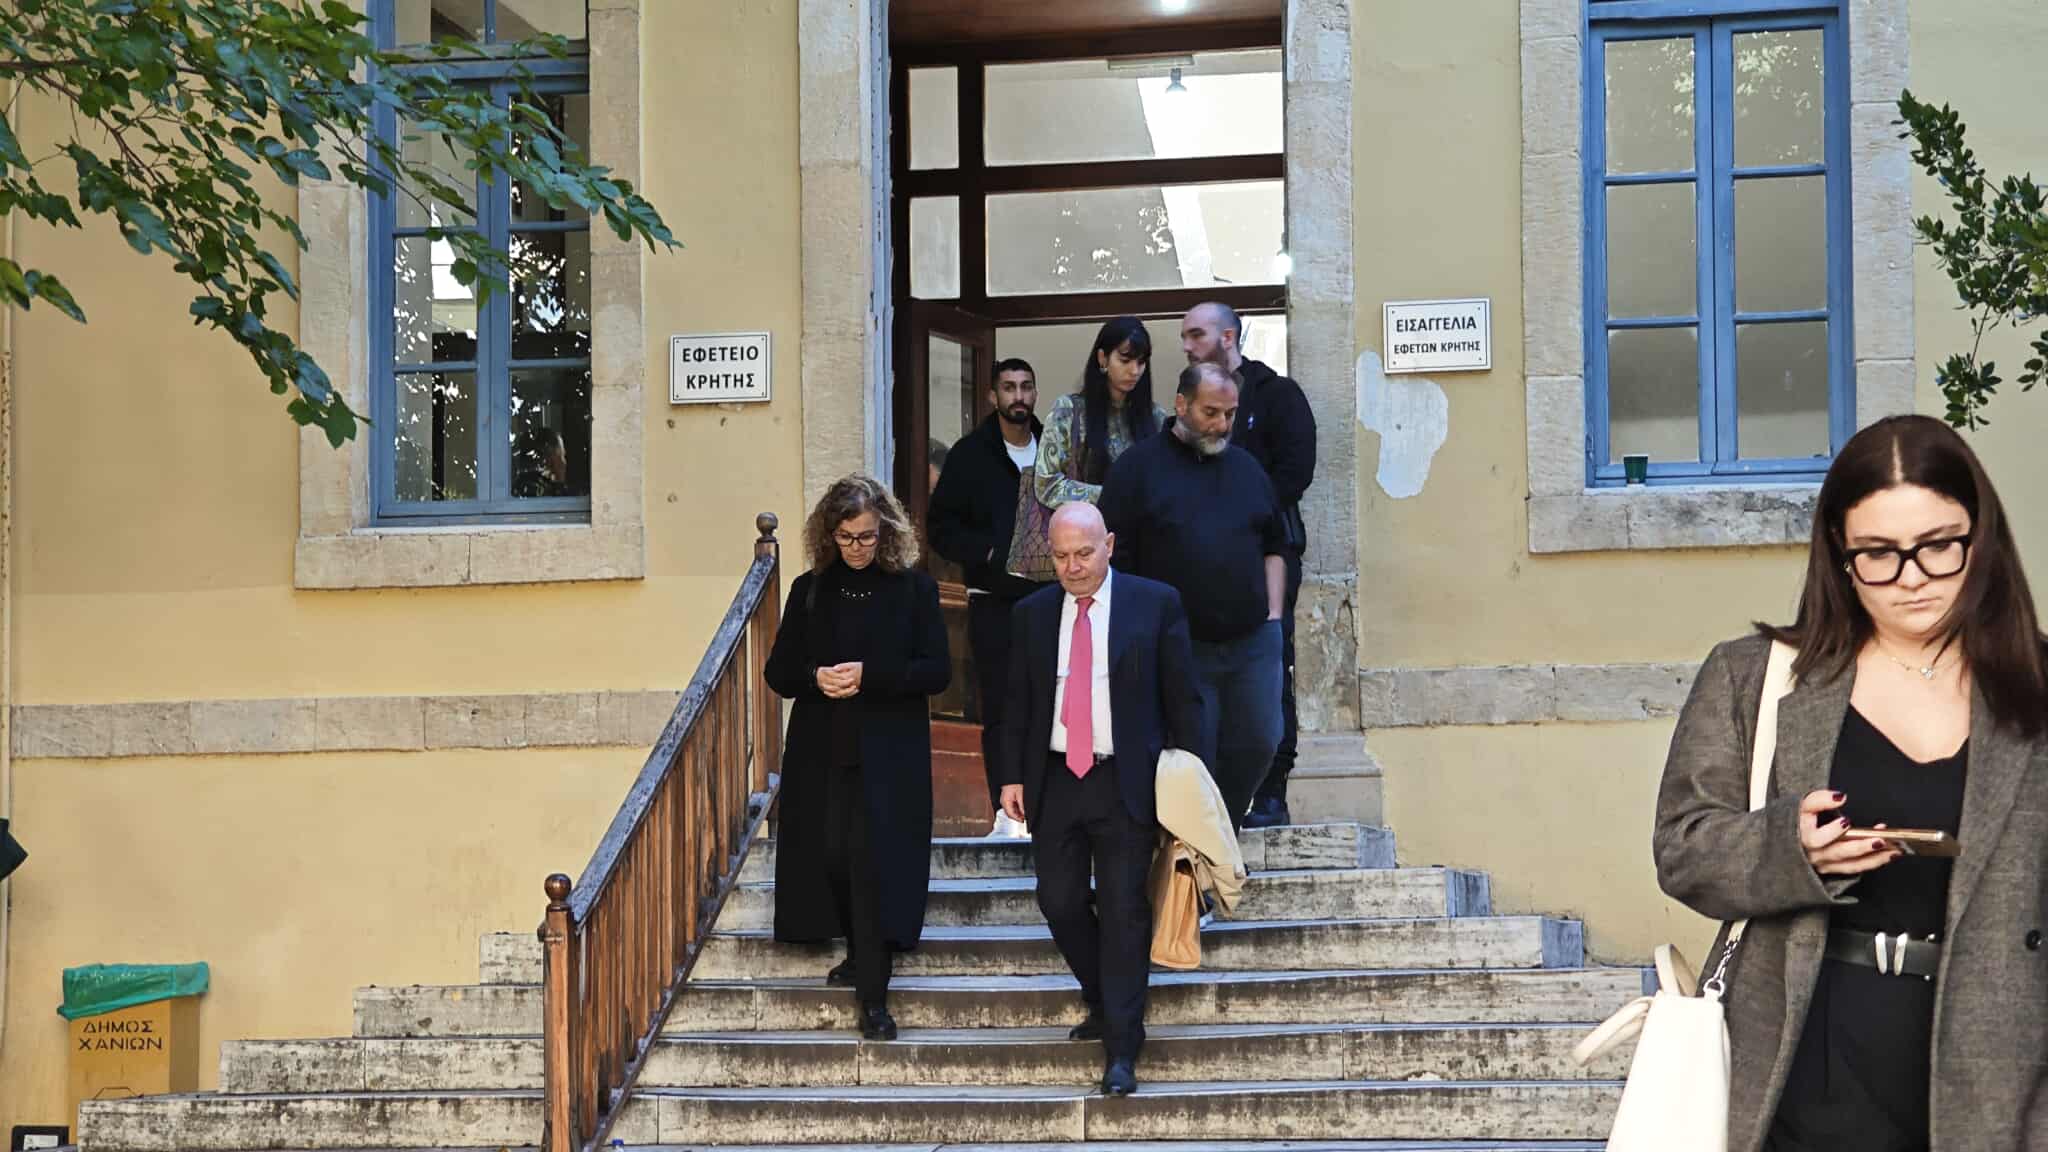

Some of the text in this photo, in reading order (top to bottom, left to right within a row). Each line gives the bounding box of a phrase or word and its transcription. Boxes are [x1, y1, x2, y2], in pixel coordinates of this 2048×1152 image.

[1396, 316, 1477, 333] ΕΙΣΑΓΓΕΛΙΑ
[682, 345, 759, 363] ΕΦΕΤΕΙΟ
[1394, 340, 1481, 354] ΕΦΕΤΩΝ ΚΡΗΤΗΣ
[686, 373, 755, 390] ΚΡΗΤΗΣ
[83, 1020, 153, 1034] ΔΗΜΟΣ
[79, 1037, 163, 1051] ΧΑΝΙΩΝ
